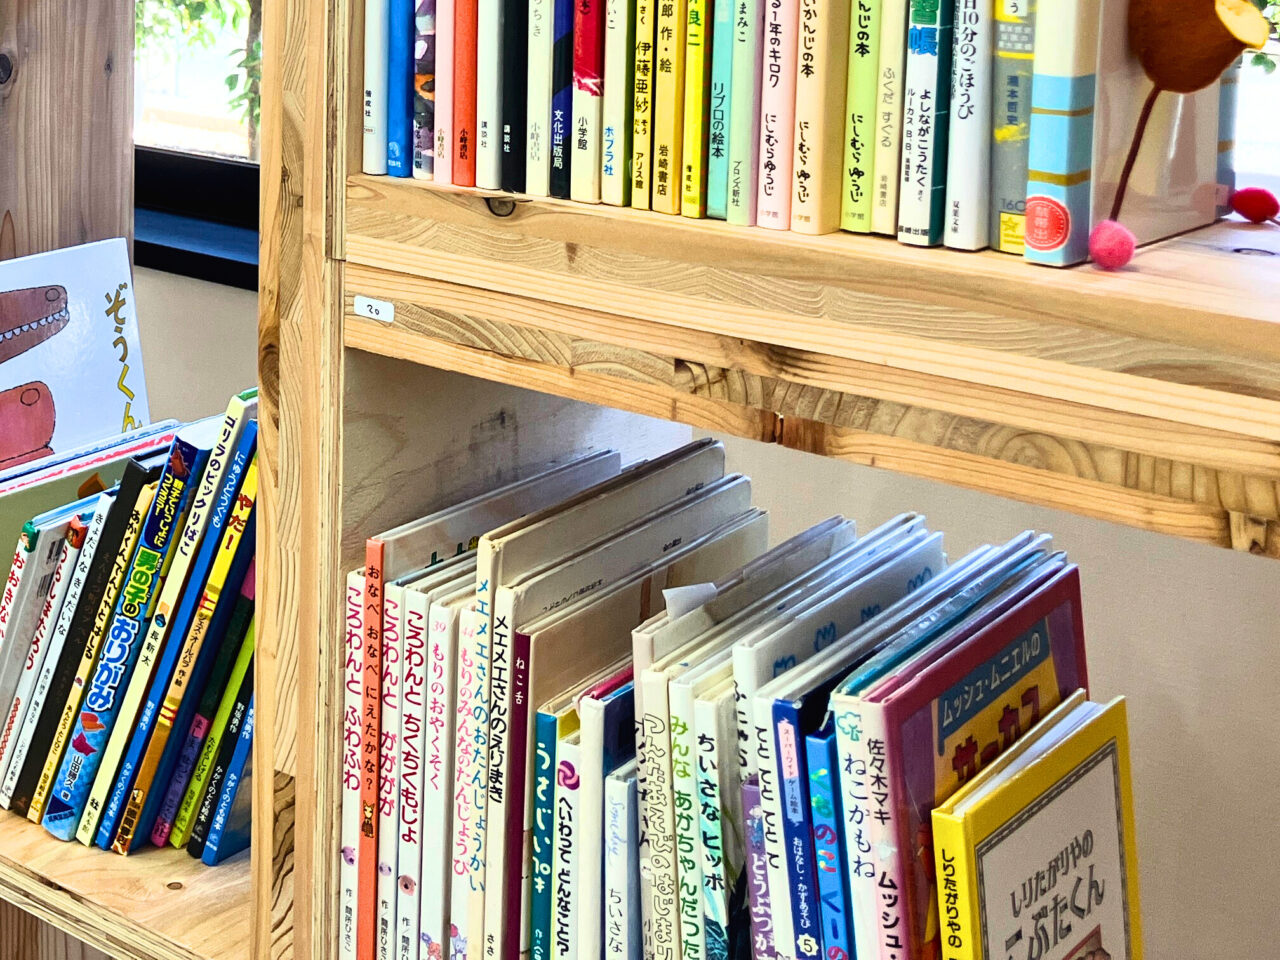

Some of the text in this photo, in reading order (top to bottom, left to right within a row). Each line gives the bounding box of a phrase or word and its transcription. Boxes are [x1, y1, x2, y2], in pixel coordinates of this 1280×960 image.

[634, 40, 652, 115] 伊藤亜紗
[659, 26, 674, 74] 作・絵
[552, 108, 565, 170] 文化出版局
[577, 115, 589, 151] 小学館
[602, 125, 616, 177] ポプラ社
[711, 82, 725, 159] リブロの絵本
[764, 113, 779, 197] にしむらゆうじ
[796, 121, 812, 204] にしむらゆうじ
[847, 113, 865, 204] にしむらゆうじ
[915, 89, 933, 188] よしながこうたく
[655, 143, 670, 196] 岩崎書店
[731, 160, 743, 208] ブロンズ新社
[366, 303, 380, 316] 20
[103, 281, 144, 434] ぞうくん
[178, 414, 239, 559] ゴリラのビックリばこ
[222, 491, 254, 552] やだ！
[26, 543, 70, 672] うらしまたろう
[57, 511, 105, 636] きょだいな きょだいな
[122, 545, 154, 619] 男の子の
[84, 613, 143, 714] おりがみ
[140, 629, 160, 670] 長新太
[343, 586, 364, 791] ころわんと ふわふわ
[363, 564, 380, 791] おなべ おなべ にえたかな？
[403, 610, 425, 707] ころわんと
[941, 630, 1041, 727] ムッシュ・ムニエルの
[378, 598, 400, 817] ころわんと がががが
[429, 641, 446, 791] もりのおやくそく
[470, 579, 490, 893] メエメエさんのおたんじょうかい
[489, 615, 509, 804] メエメエさんのえりまき
[671, 714, 691, 780] みんな
[453, 647, 474, 876] もりのみんなのたんじょうび
[866, 737, 892, 827] 佐々木マキ
[697, 731, 726, 893] ちいさな ヒッポ
[843, 752, 877, 880] ねこかもね
[940, 847, 963, 950] しりたがりやの
[1009, 829, 1095, 919] しりたがりやの
